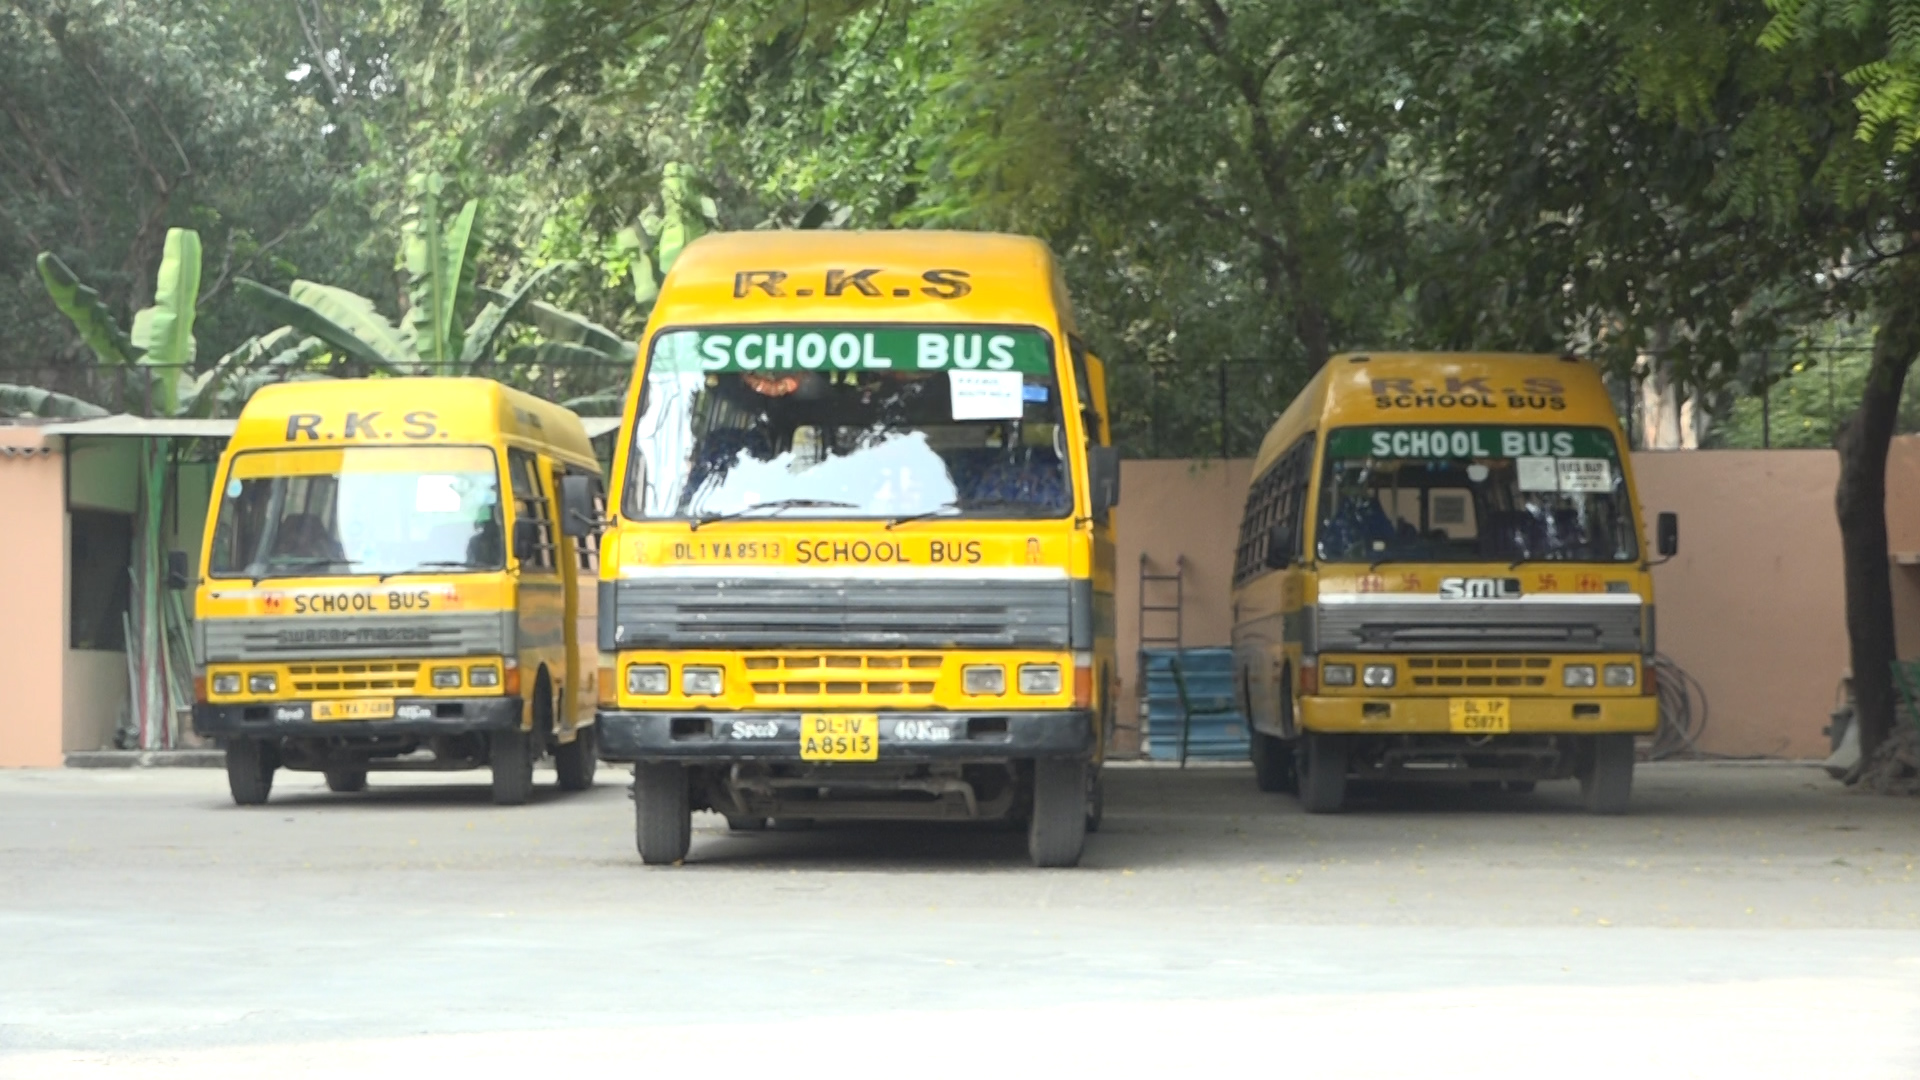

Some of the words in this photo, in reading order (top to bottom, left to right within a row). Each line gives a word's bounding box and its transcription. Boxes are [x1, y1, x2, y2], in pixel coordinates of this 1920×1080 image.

[701, 332, 892, 369] SCHOOL
[917, 332, 1016, 370] BUS
[1376, 394, 1497, 410] SCHOOL
[1507, 394, 1567, 411] BUS
[1371, 430, 1490, 457] SCHOOL
[1501, 430, 1575, 457] BUS
[796, 540, 911, 563] SCHOOL
[929, 541, 983, 563] BUS
[294, 594, 377, 614] SCHOOL
[388, 591, 431, 610] BUS
